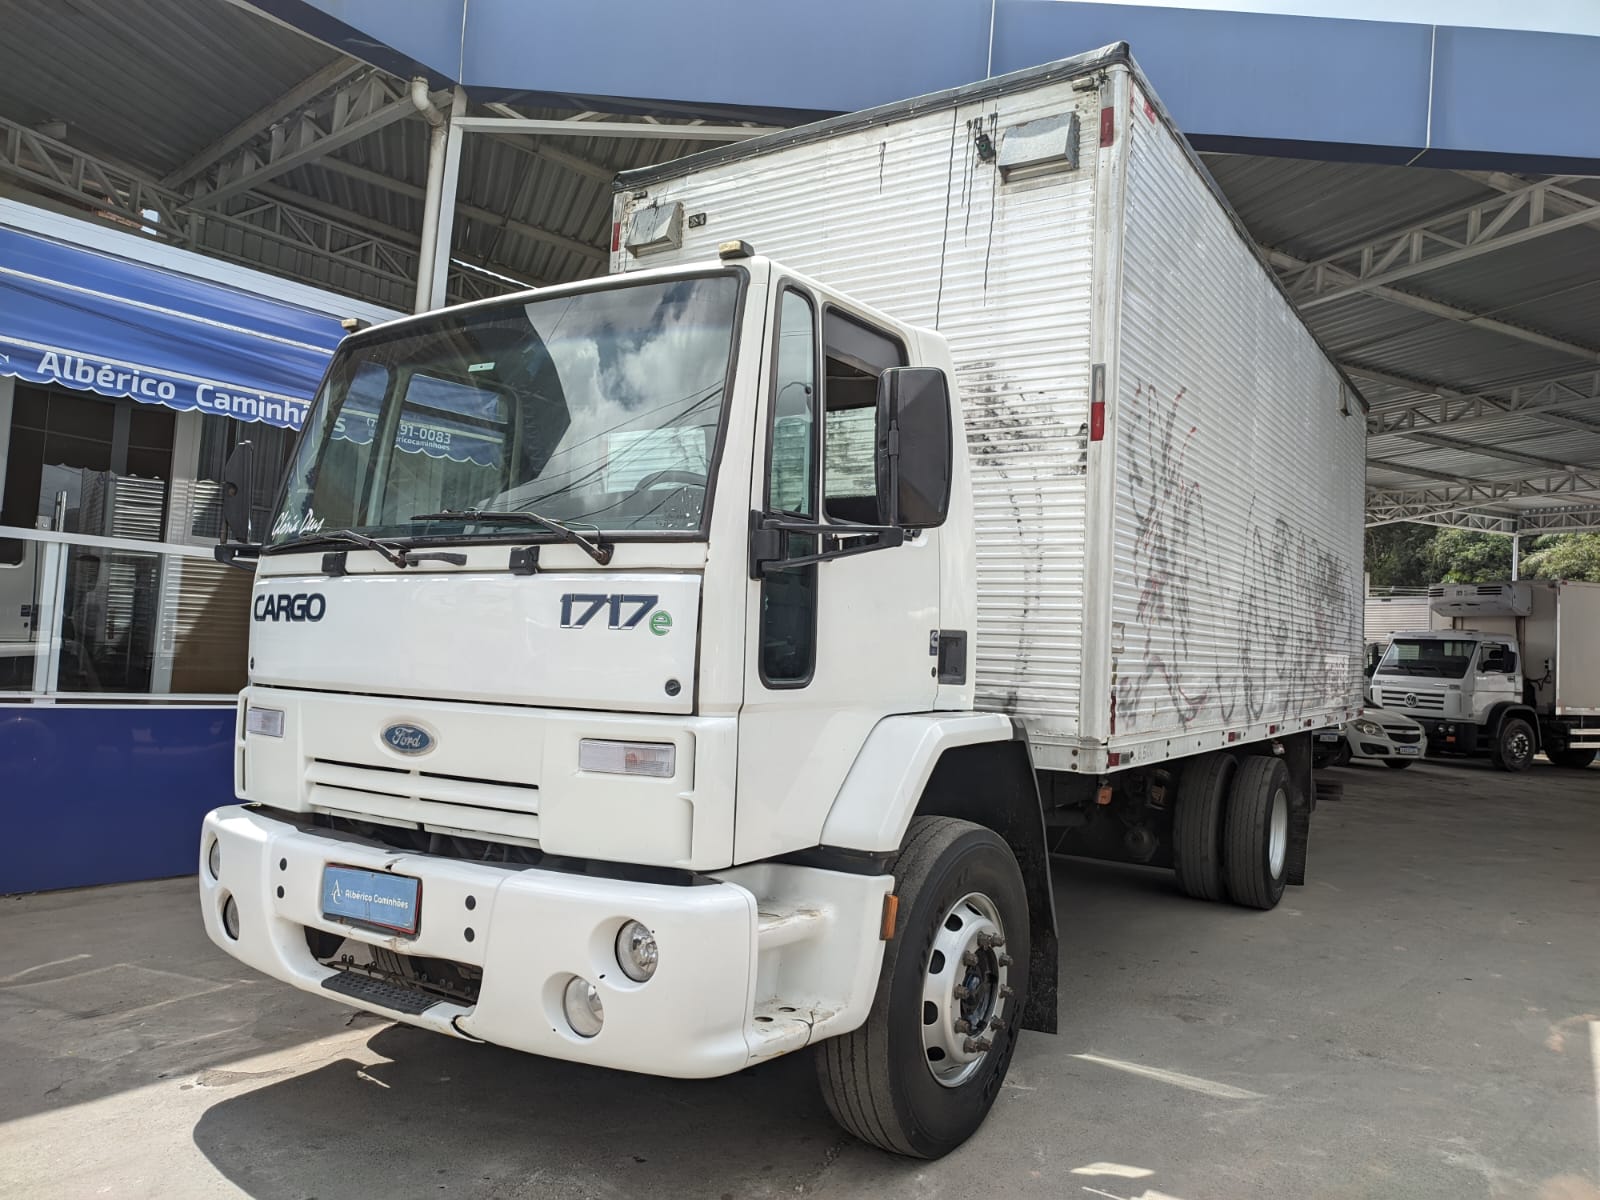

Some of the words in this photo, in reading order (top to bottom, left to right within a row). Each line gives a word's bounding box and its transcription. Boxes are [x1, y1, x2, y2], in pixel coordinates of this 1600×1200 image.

[37, 351, 176, 400] Albérico
[253, 592, 327, 623] CARGO
[391, 726, 422, 748] Ford
[344, 888, 373, 903] Albérico
